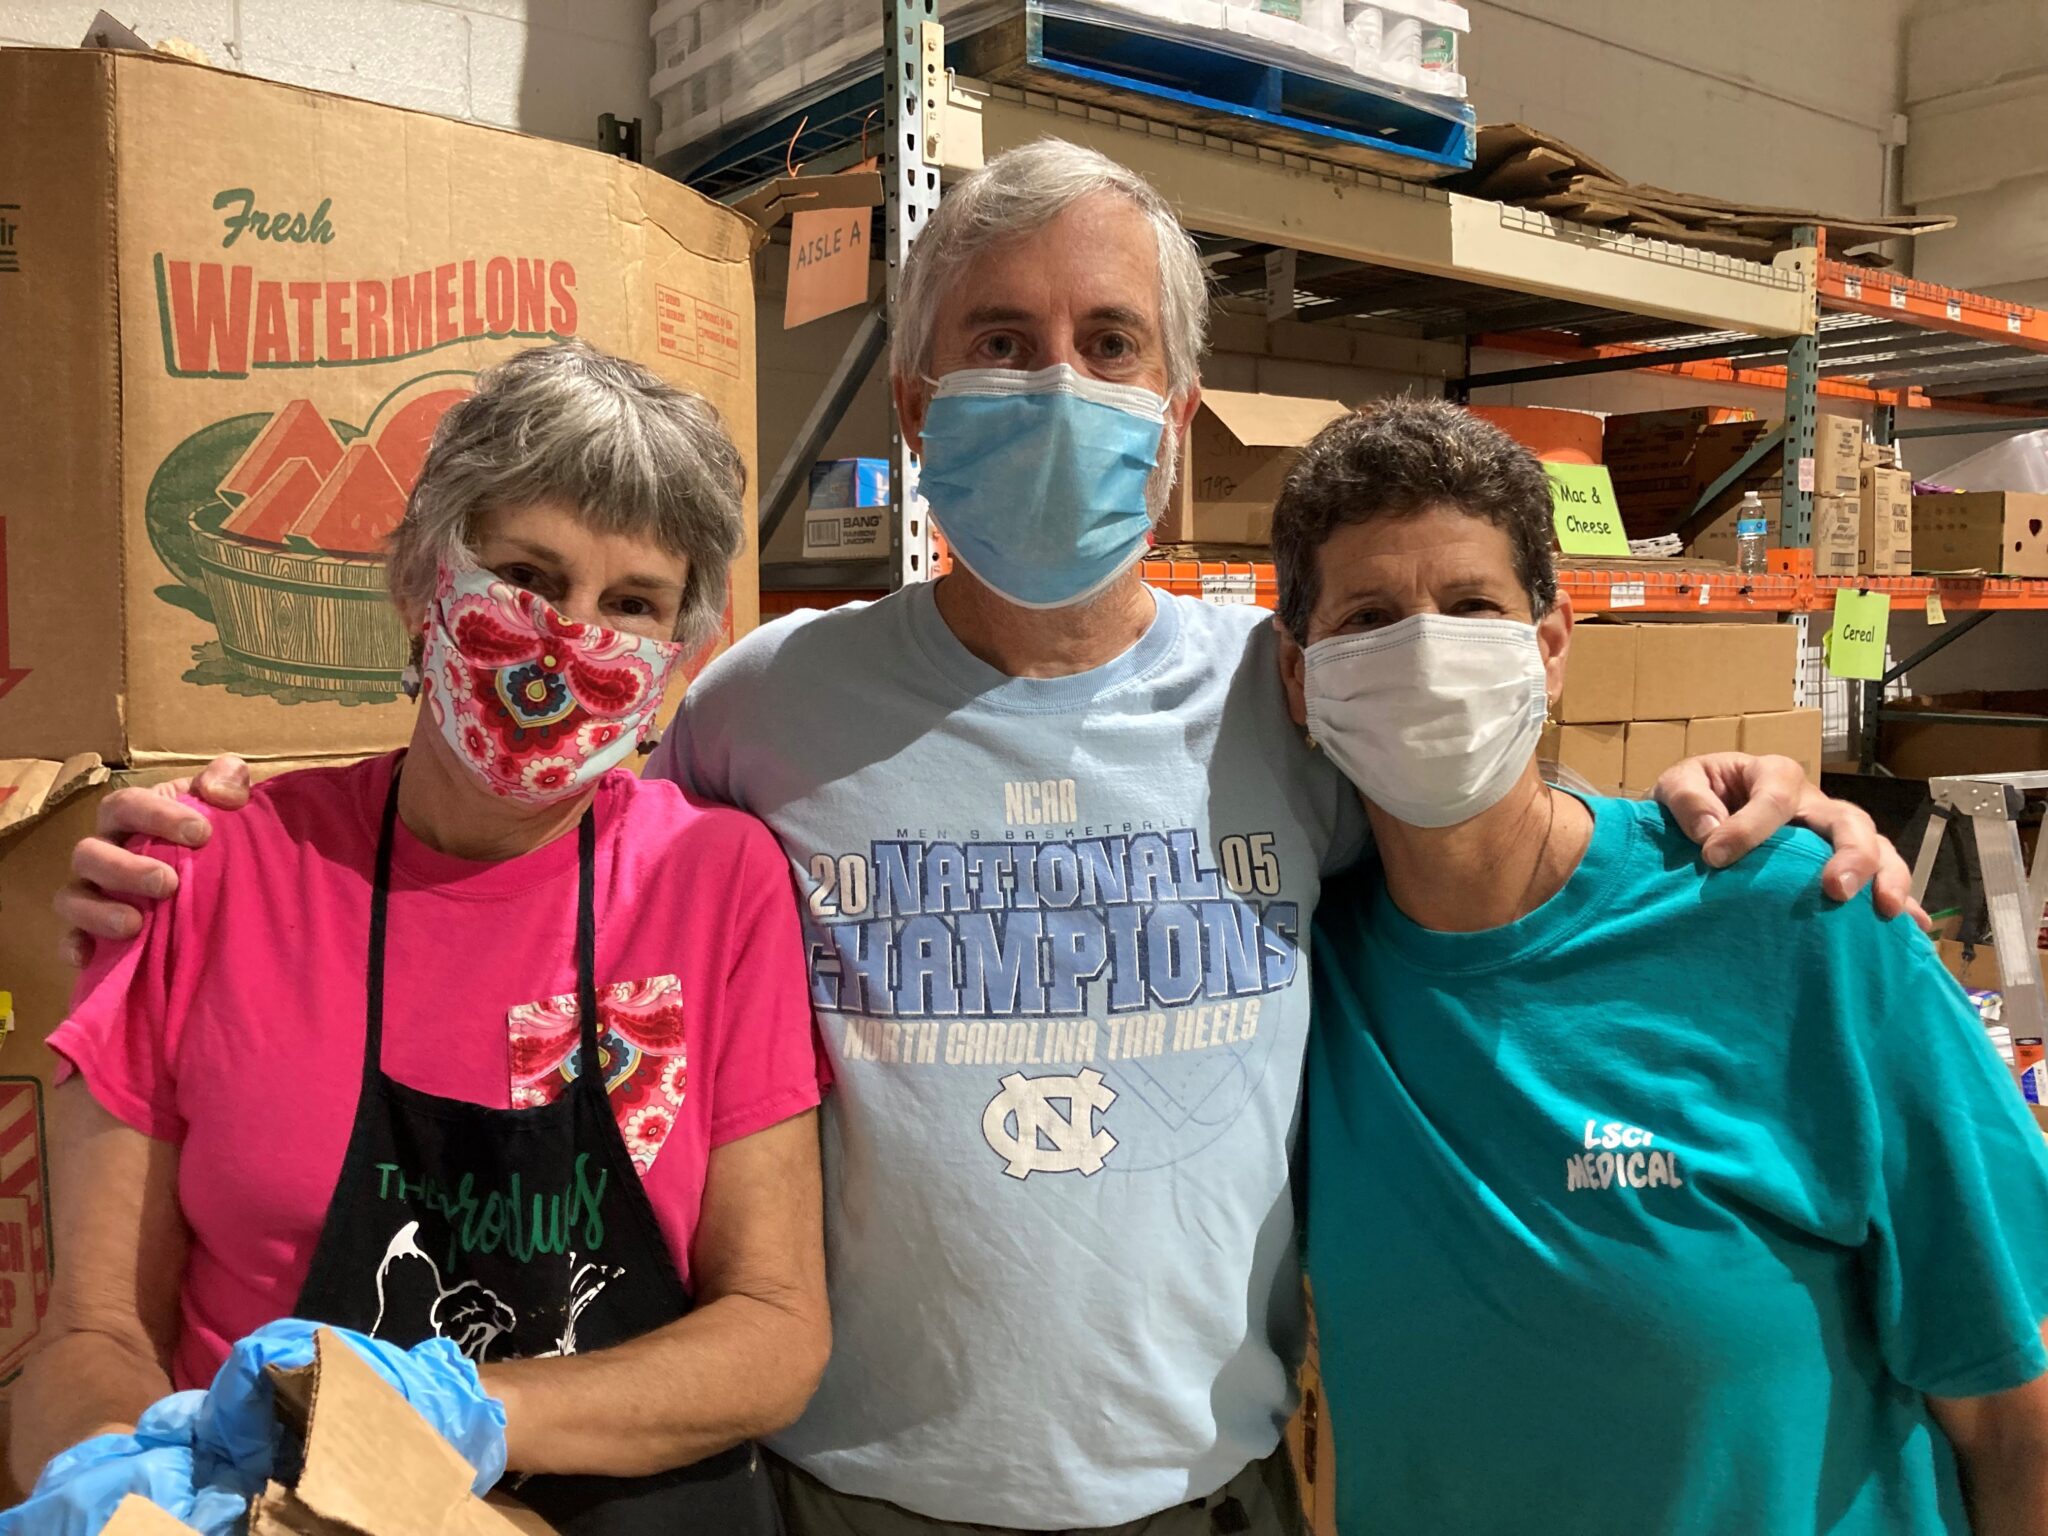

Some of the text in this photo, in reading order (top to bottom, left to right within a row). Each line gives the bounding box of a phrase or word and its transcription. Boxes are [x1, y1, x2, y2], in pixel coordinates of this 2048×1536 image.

[212, 187, 335, 249] Fresh
[796, 219, 861, 271] AISLE A
[160, 254, 580, 376] WATERMELONS
[1560, 484, 1602, 505] Mac &
[842, 515, 880, 529] BANG
[1566, 514, 1611, 535] Cheese
[1843, 623, 1875, 643] Cereal
[1004, 778, 1077, 826] NCAA
[1005, 818, 1190, 841] BASKETBALL
[808, 828, 1282, 919] 20 NATIONAL 05
[843, 998, 1262, 1065] NORTH CAROLINA TAR HEELS
[1566, 1151, 1683, 1192] MEDICAL
